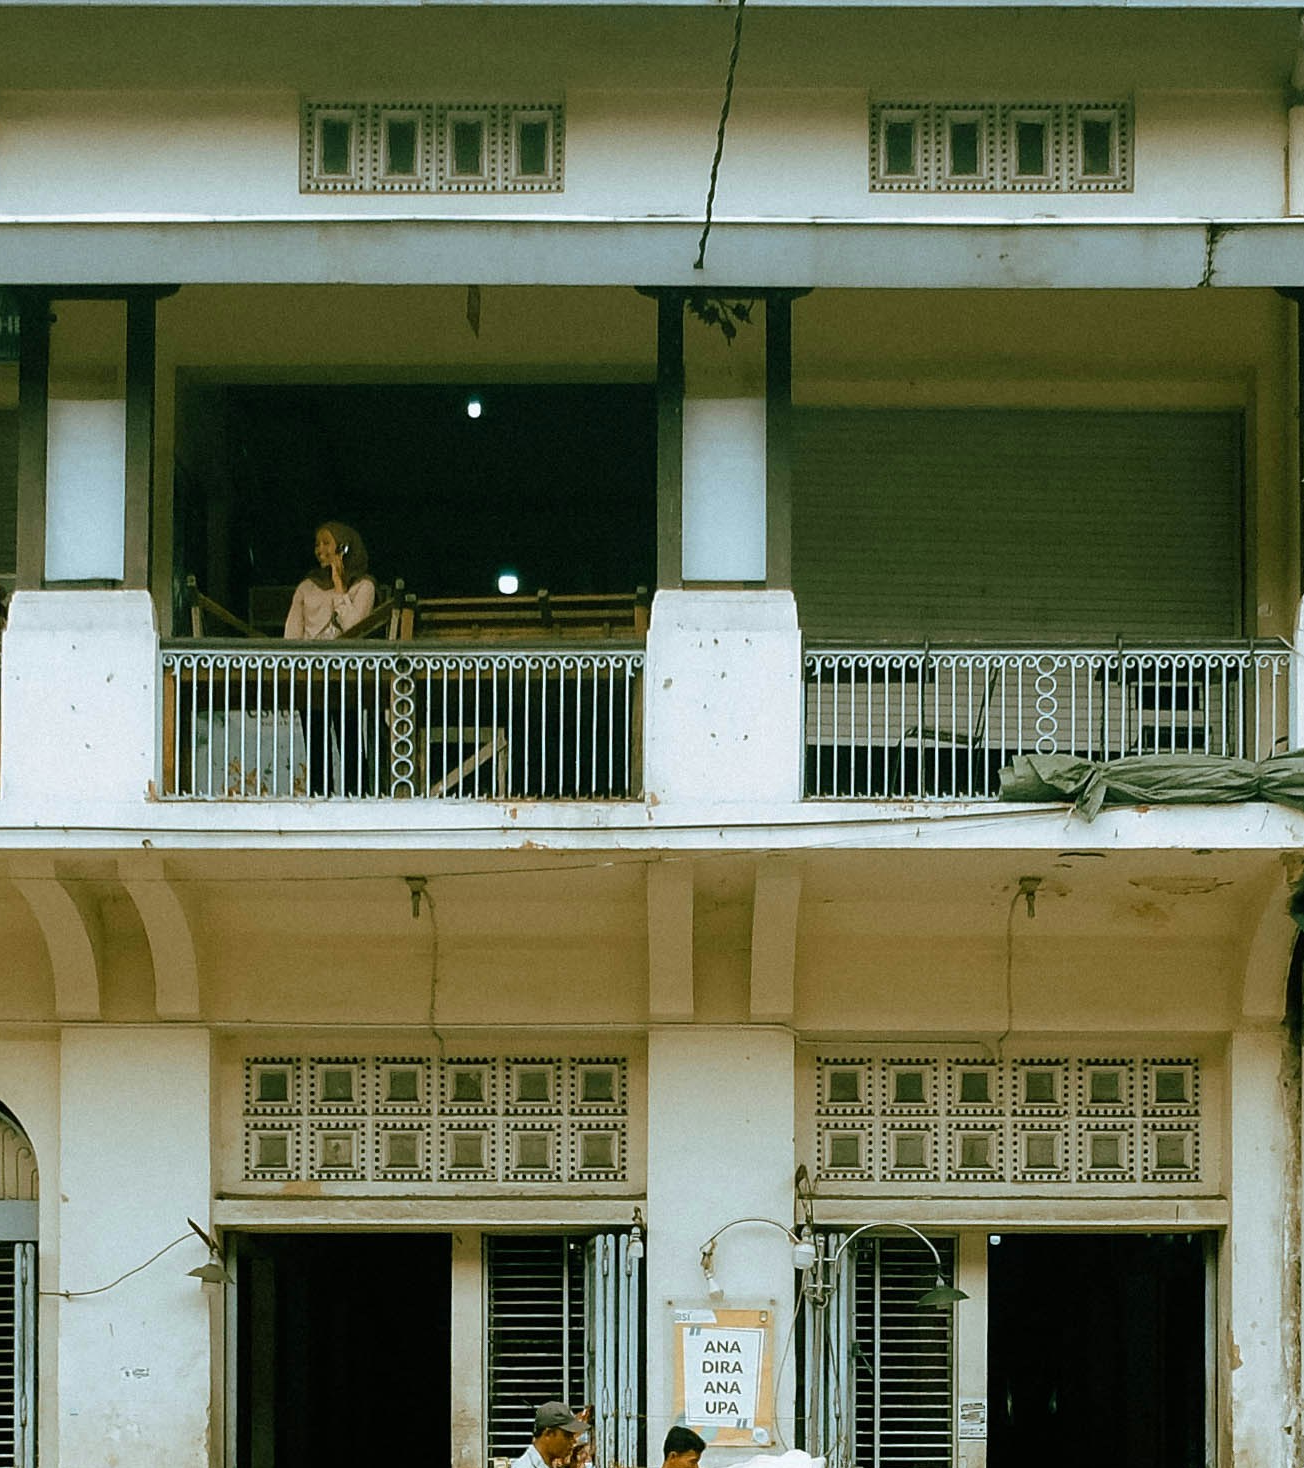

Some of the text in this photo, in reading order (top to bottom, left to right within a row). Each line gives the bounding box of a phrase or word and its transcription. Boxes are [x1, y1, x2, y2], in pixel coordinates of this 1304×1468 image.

[704, 1340, 742, 1354] ANA
[701, 1360, 744, 1374] DIRA
[703, 1381, 742, 1395] ANA
[704, 1401, 740, 1415] UPA
